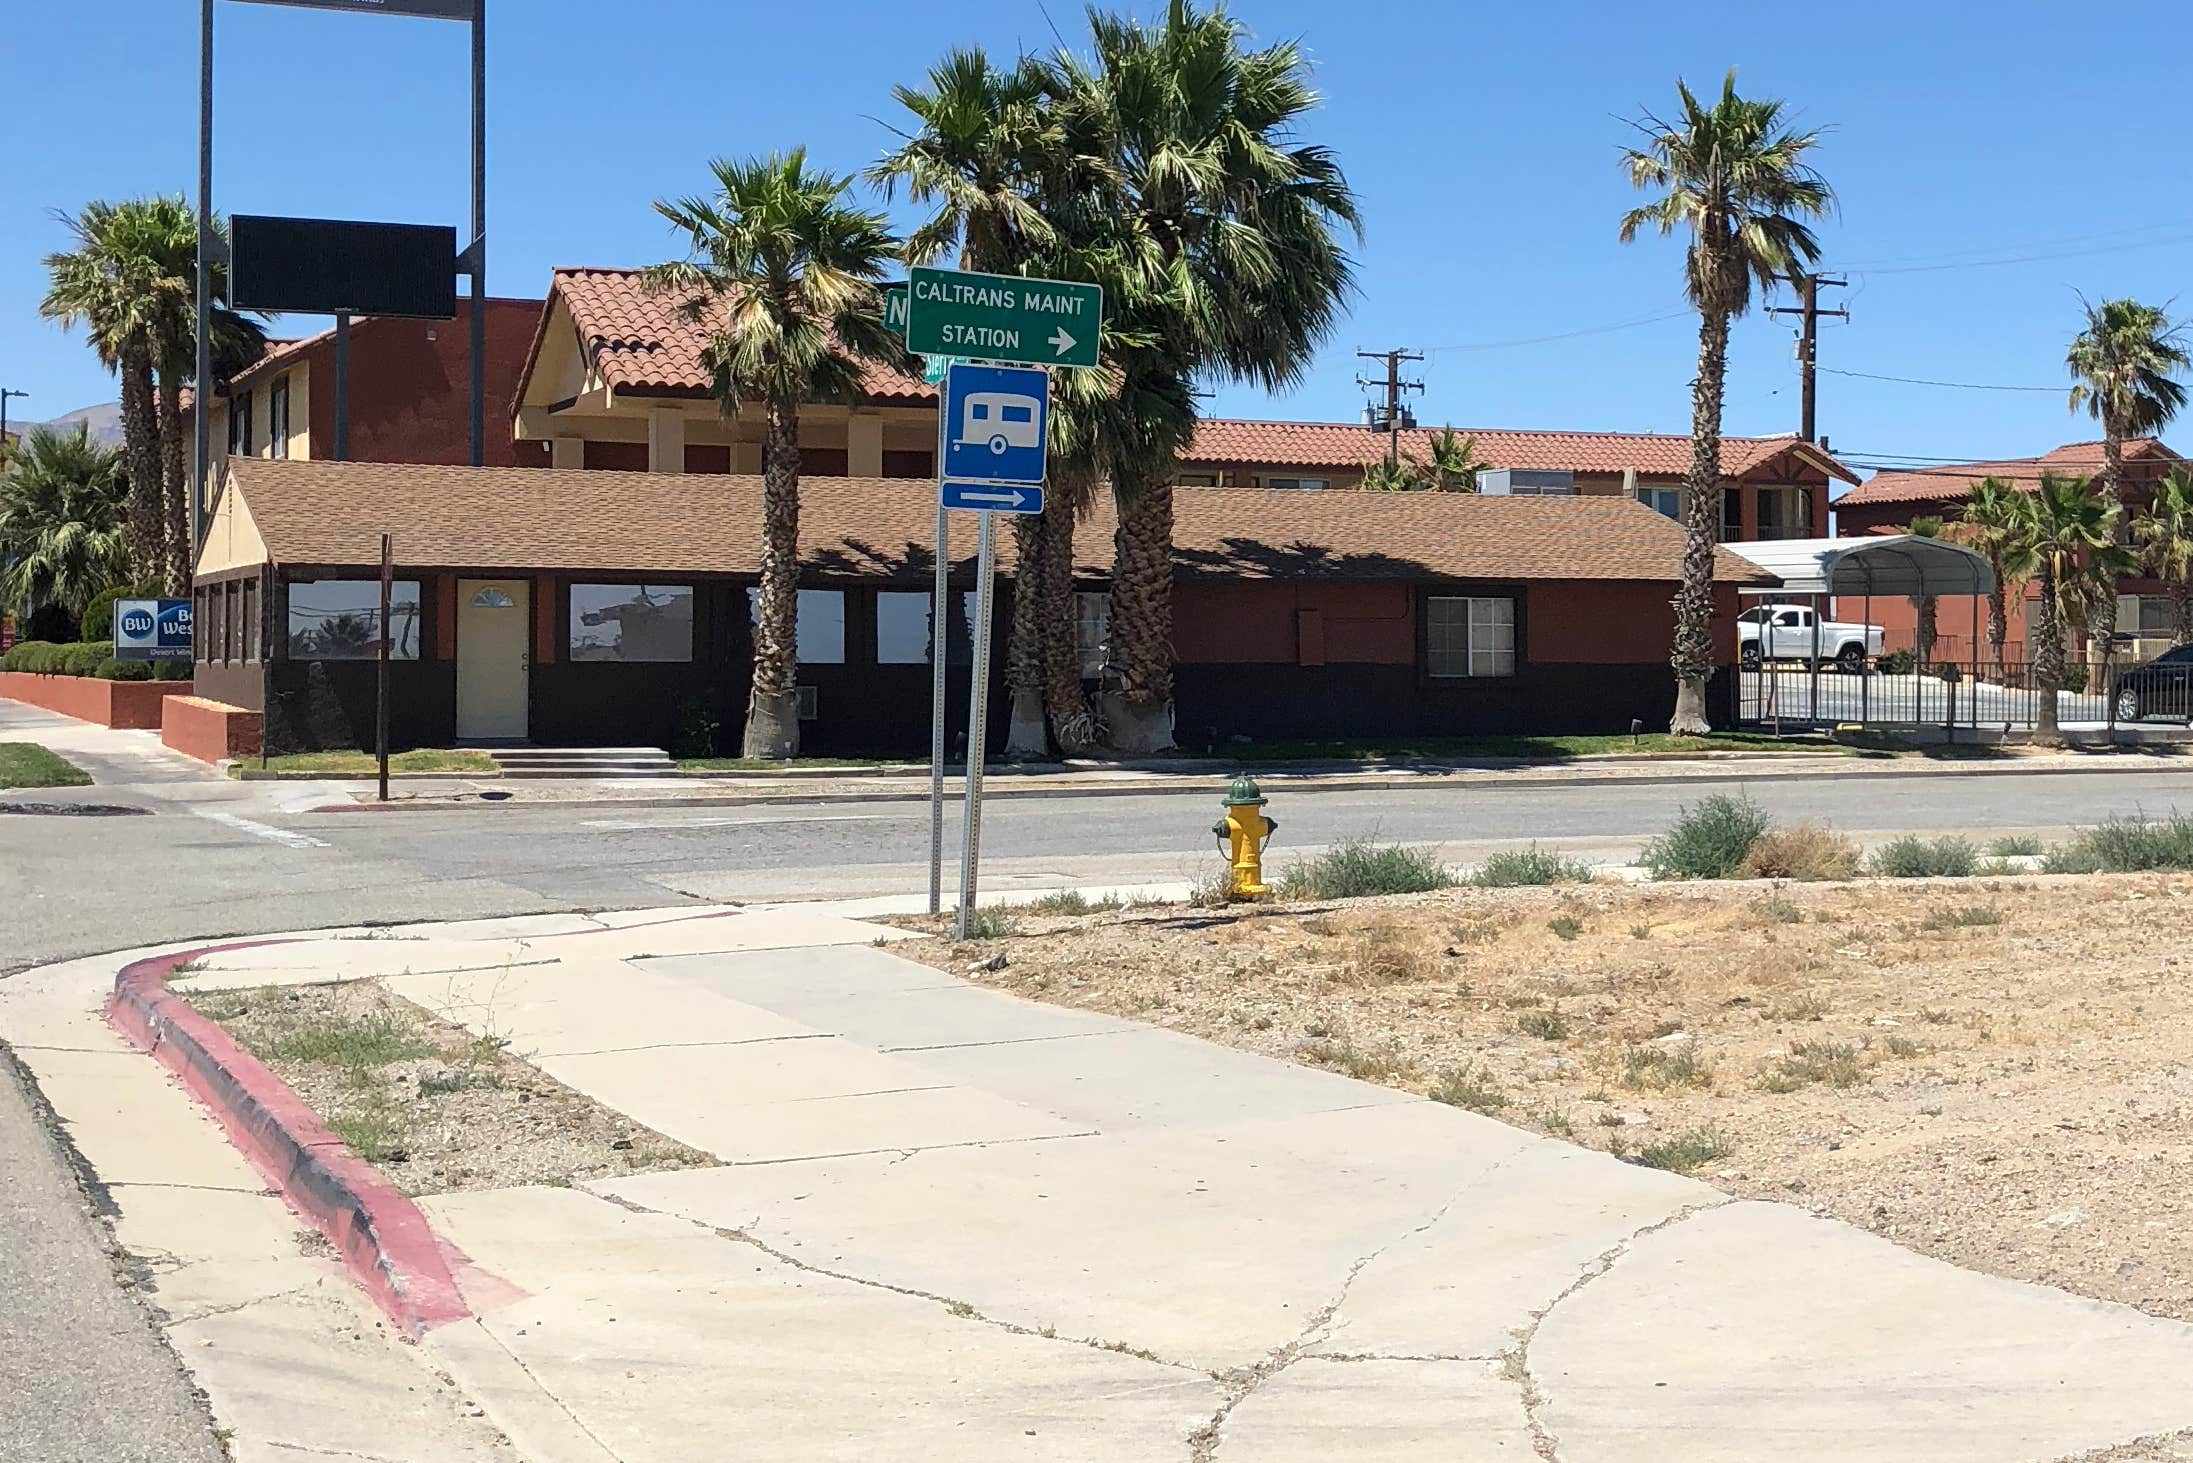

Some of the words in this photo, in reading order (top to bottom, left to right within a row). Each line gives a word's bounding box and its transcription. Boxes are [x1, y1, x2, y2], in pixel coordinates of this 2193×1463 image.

[889, 296, 908, 325] N
[915, 280, 1016, 309] CALTRANS
[1024, 293, 1085, 316] MAINT
[942, 325, 1020, 349] STATION
[125, 618, 151, 631] BW
